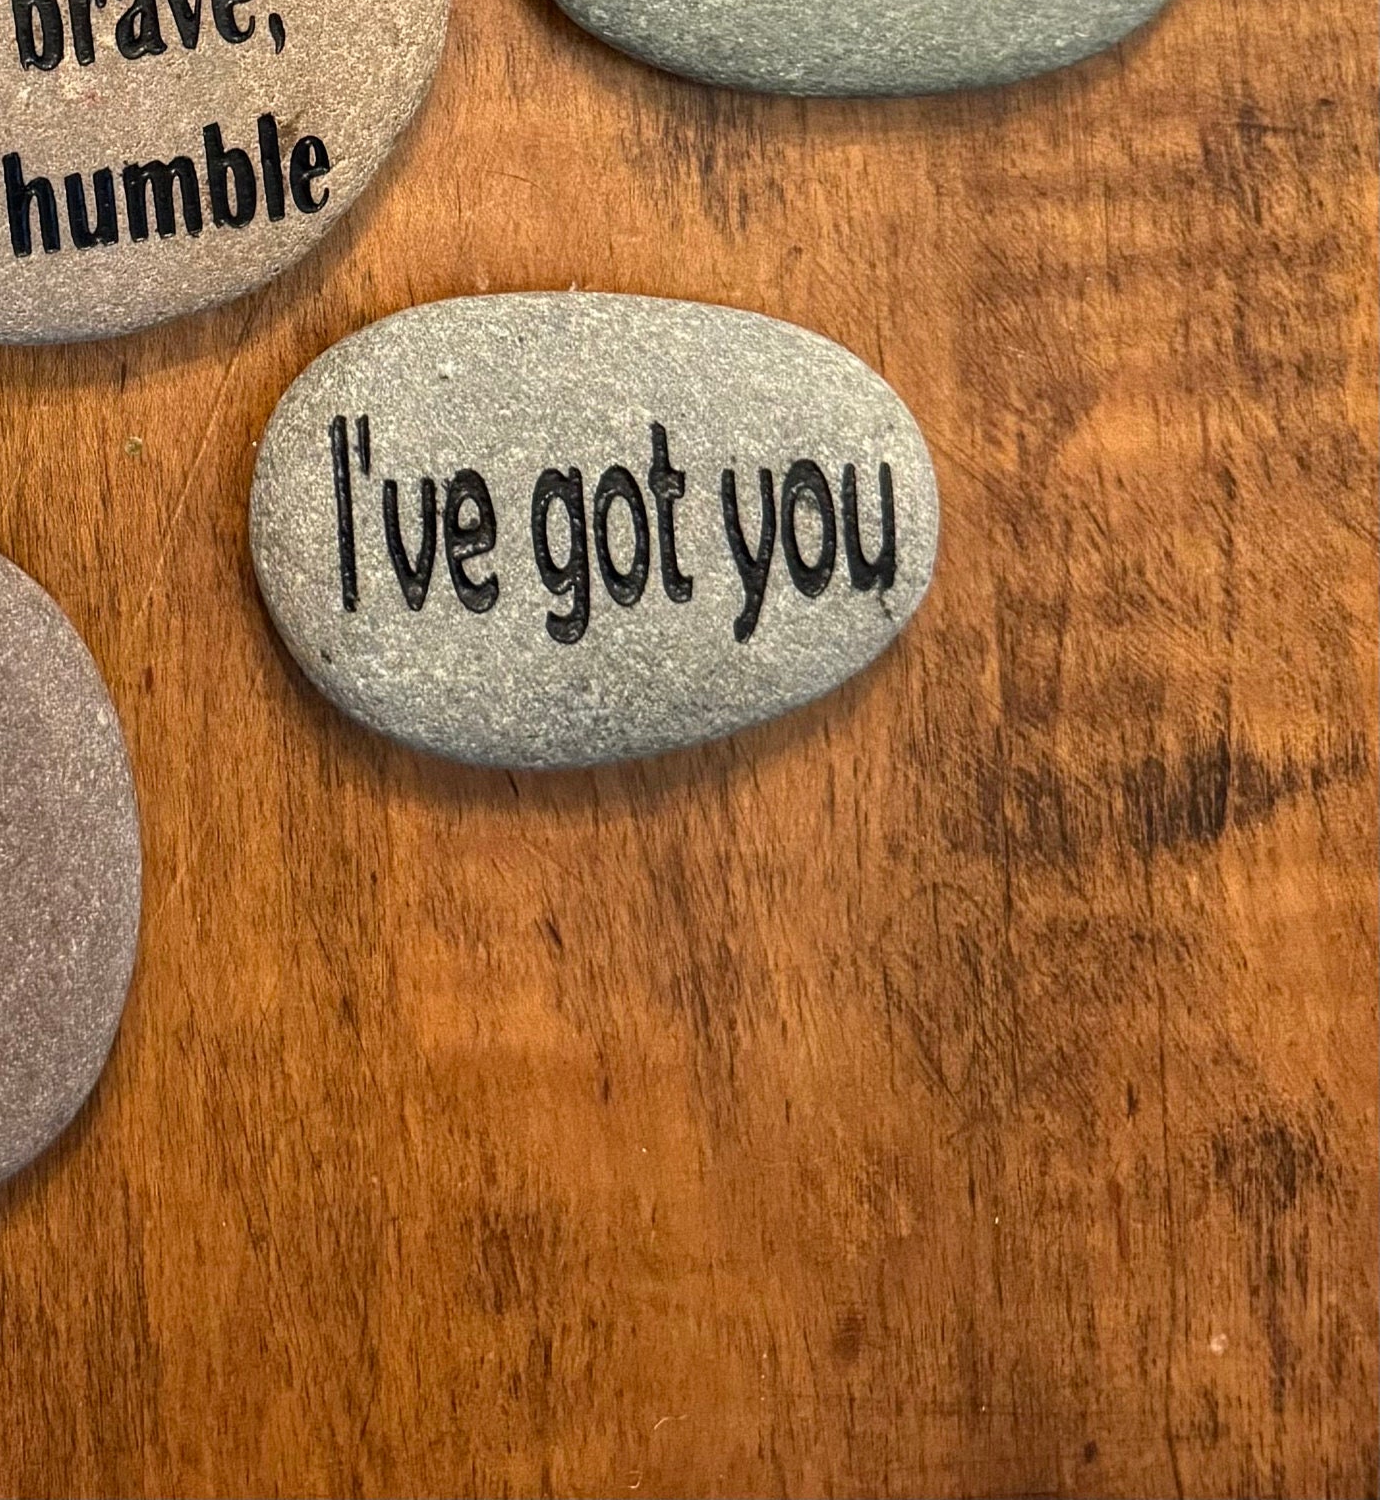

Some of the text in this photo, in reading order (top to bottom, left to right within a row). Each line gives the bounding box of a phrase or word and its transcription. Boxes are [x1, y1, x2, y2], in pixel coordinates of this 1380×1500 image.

[2, 114, 332, 259] humble
[329, 414, 896, 646] I've got you
